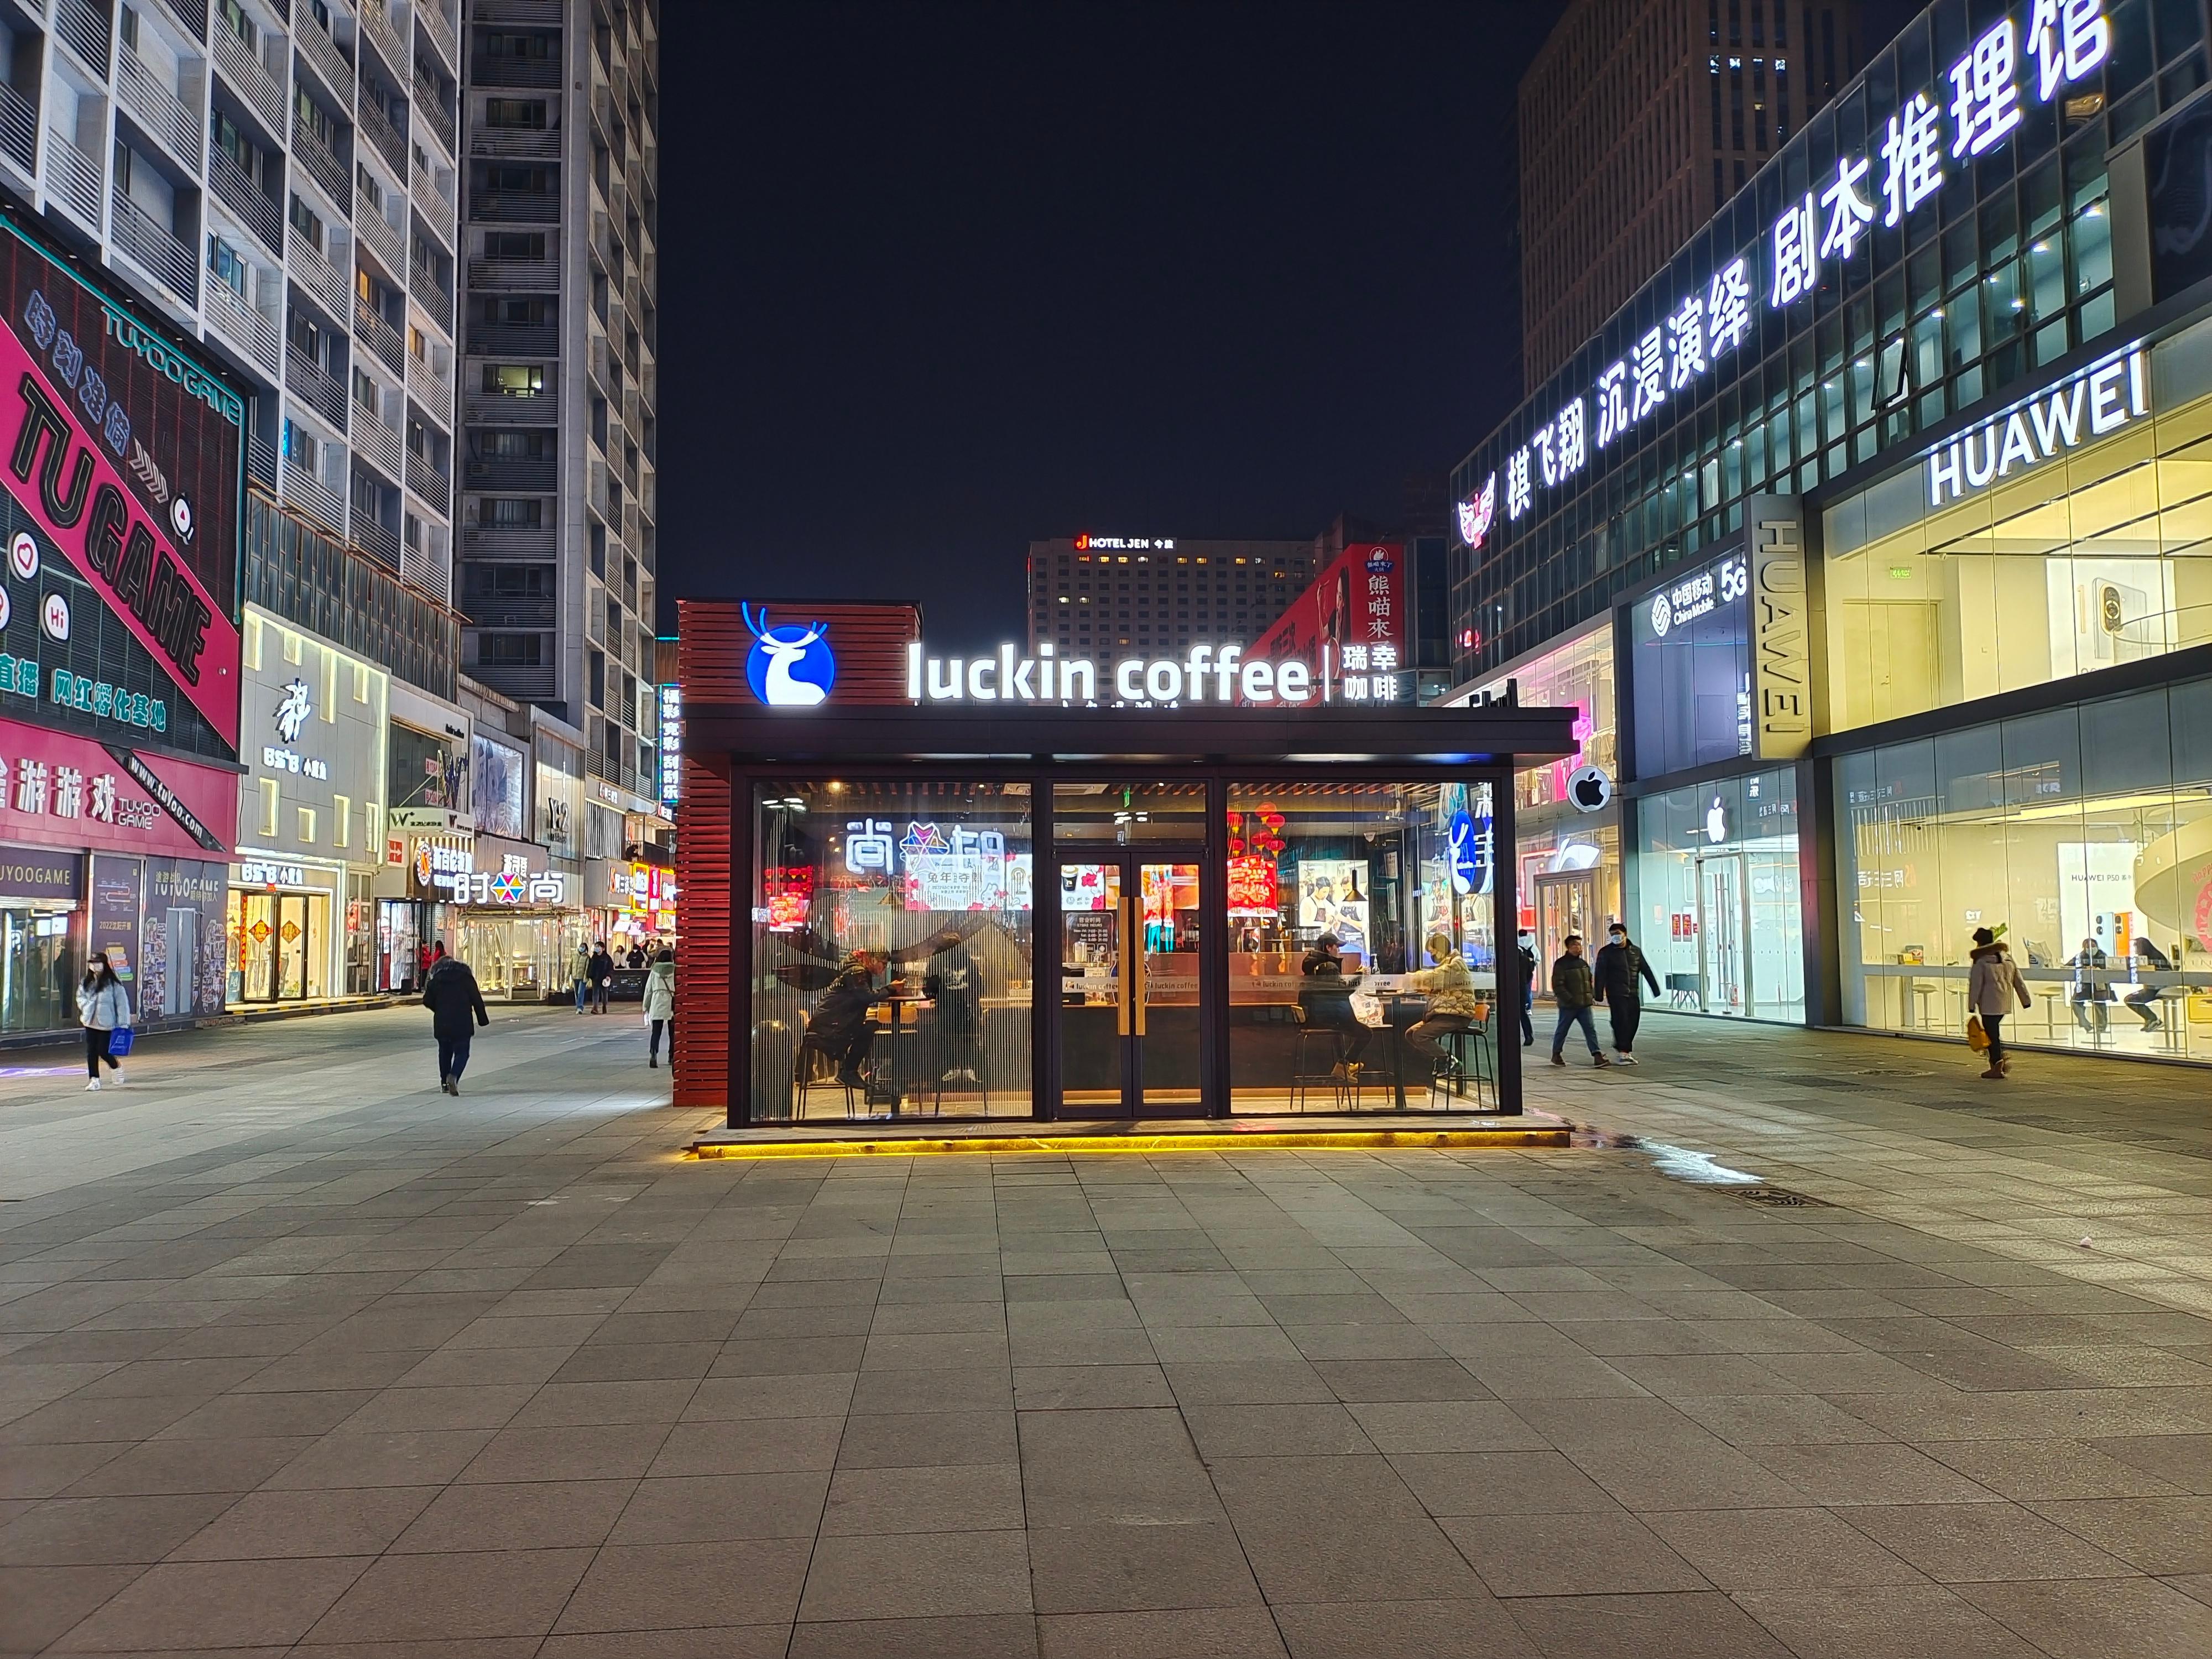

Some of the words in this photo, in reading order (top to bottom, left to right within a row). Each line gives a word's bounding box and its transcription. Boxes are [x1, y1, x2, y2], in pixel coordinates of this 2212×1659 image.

[1507, 397, 1585, 521] 棋飞翔
[1598, 258, 1749, 448] 沉浸演绎
[1771, 0, 2109, 309] 剧本推理馆
[101, 305, 242, 427] TUYOOGAME
[1931, 348, 2151, 507] HUAWEI
[1088, 538, 1126, 549] HOTEL
[1127, 539, 1150, 549] JEN
[1672, 572, 1713, 609] 中国移动
[1721, 560, 1747, 602] 5G
[50, 606, 64, 629] Hi
[1673, 609, 1693, 625] China
[1692, 597, 1715, 618] Mobile
[1757, 520, 1806, 733] HUAWEI
[907, 641, 1095, 701] luckin
[1116, 644, 1311, 702] coffee
[1343, 645, 1397, 671] 瑞幸
[54, 667, 166, 733] 网红孵化基地
[1344, 674, 1398, 701] 咖啡
[663, 755, 679, 799] 刮刮乐
[117, 812, 153, 830] GAME
[118, 797, 161, 817] TUYOO
[454, 872, 565, 905] 时尚
